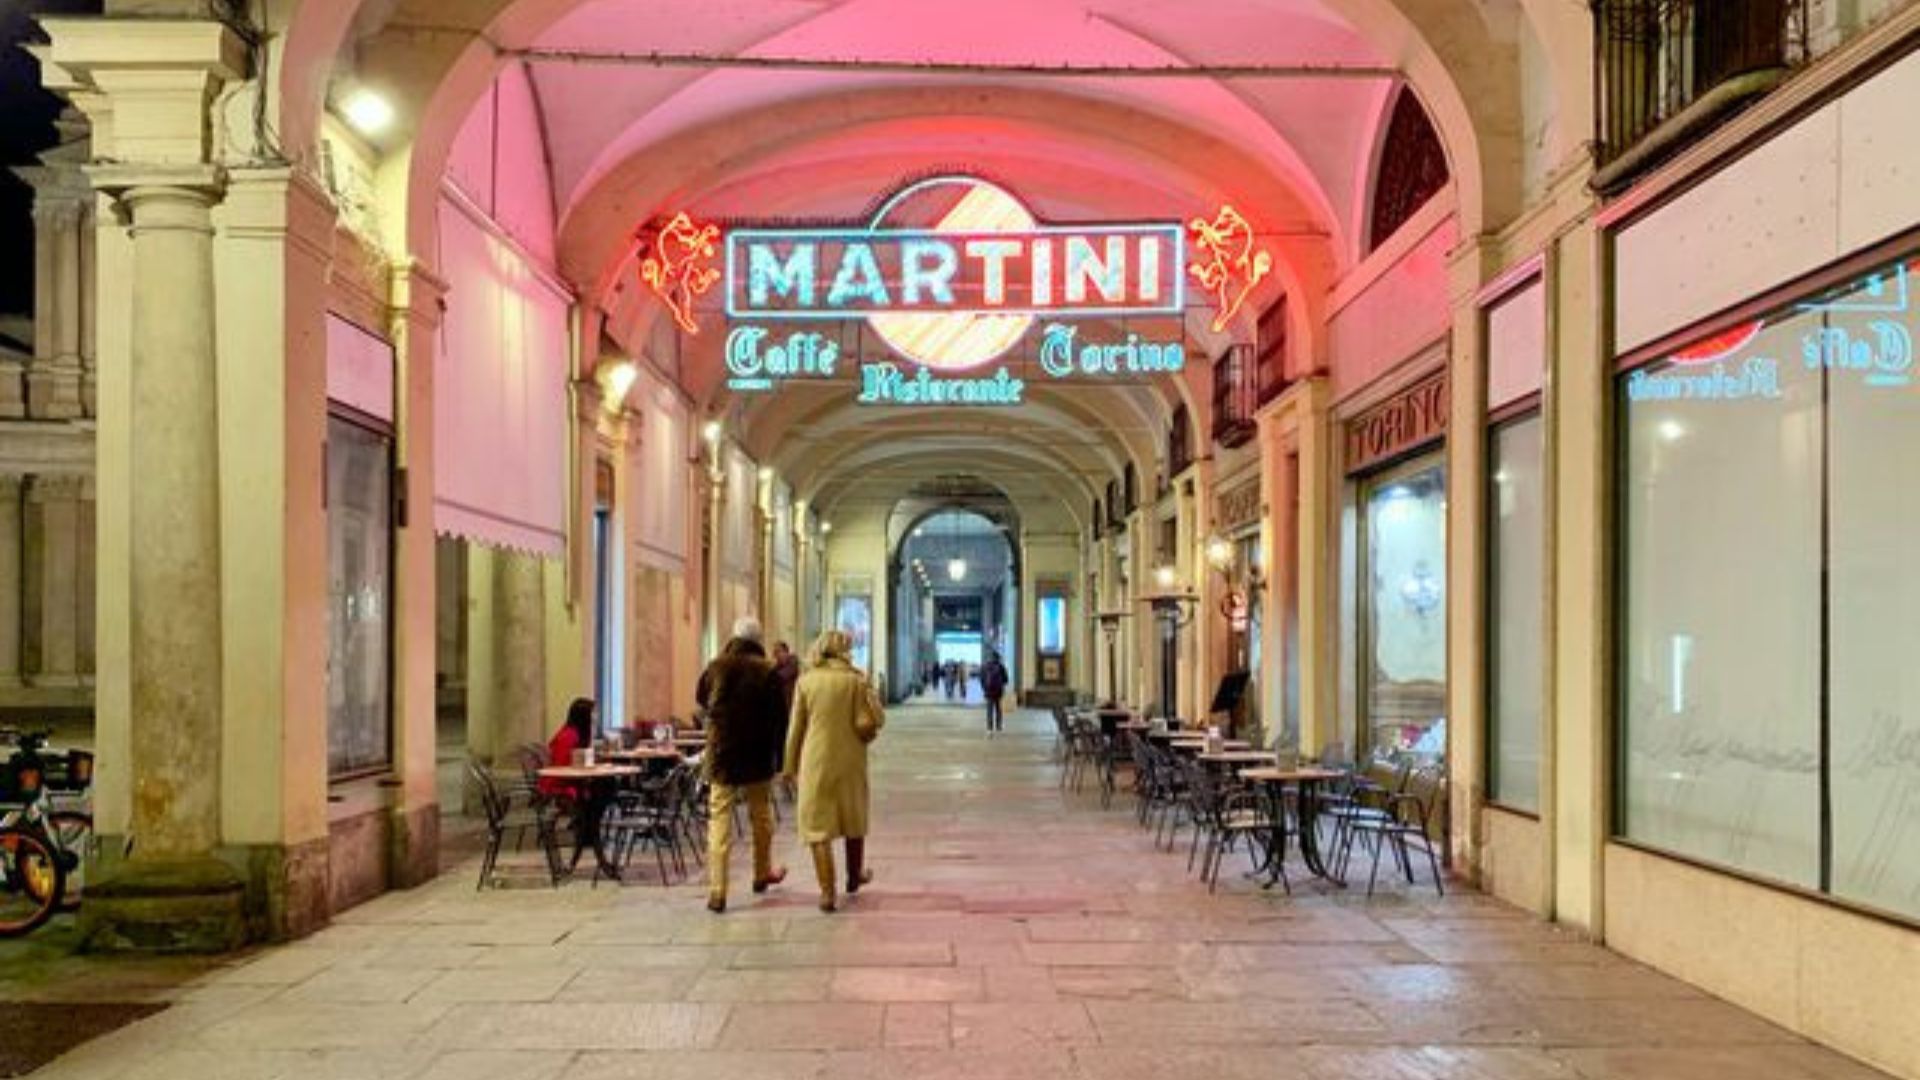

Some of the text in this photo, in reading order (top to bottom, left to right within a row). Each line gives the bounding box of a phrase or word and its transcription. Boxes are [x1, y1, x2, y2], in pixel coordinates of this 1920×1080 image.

[749, 236, 1160, 306] MARTINI
[1040, 323, 1184, 377] Torino
[858, 362, 1025, 403] Ristorante
